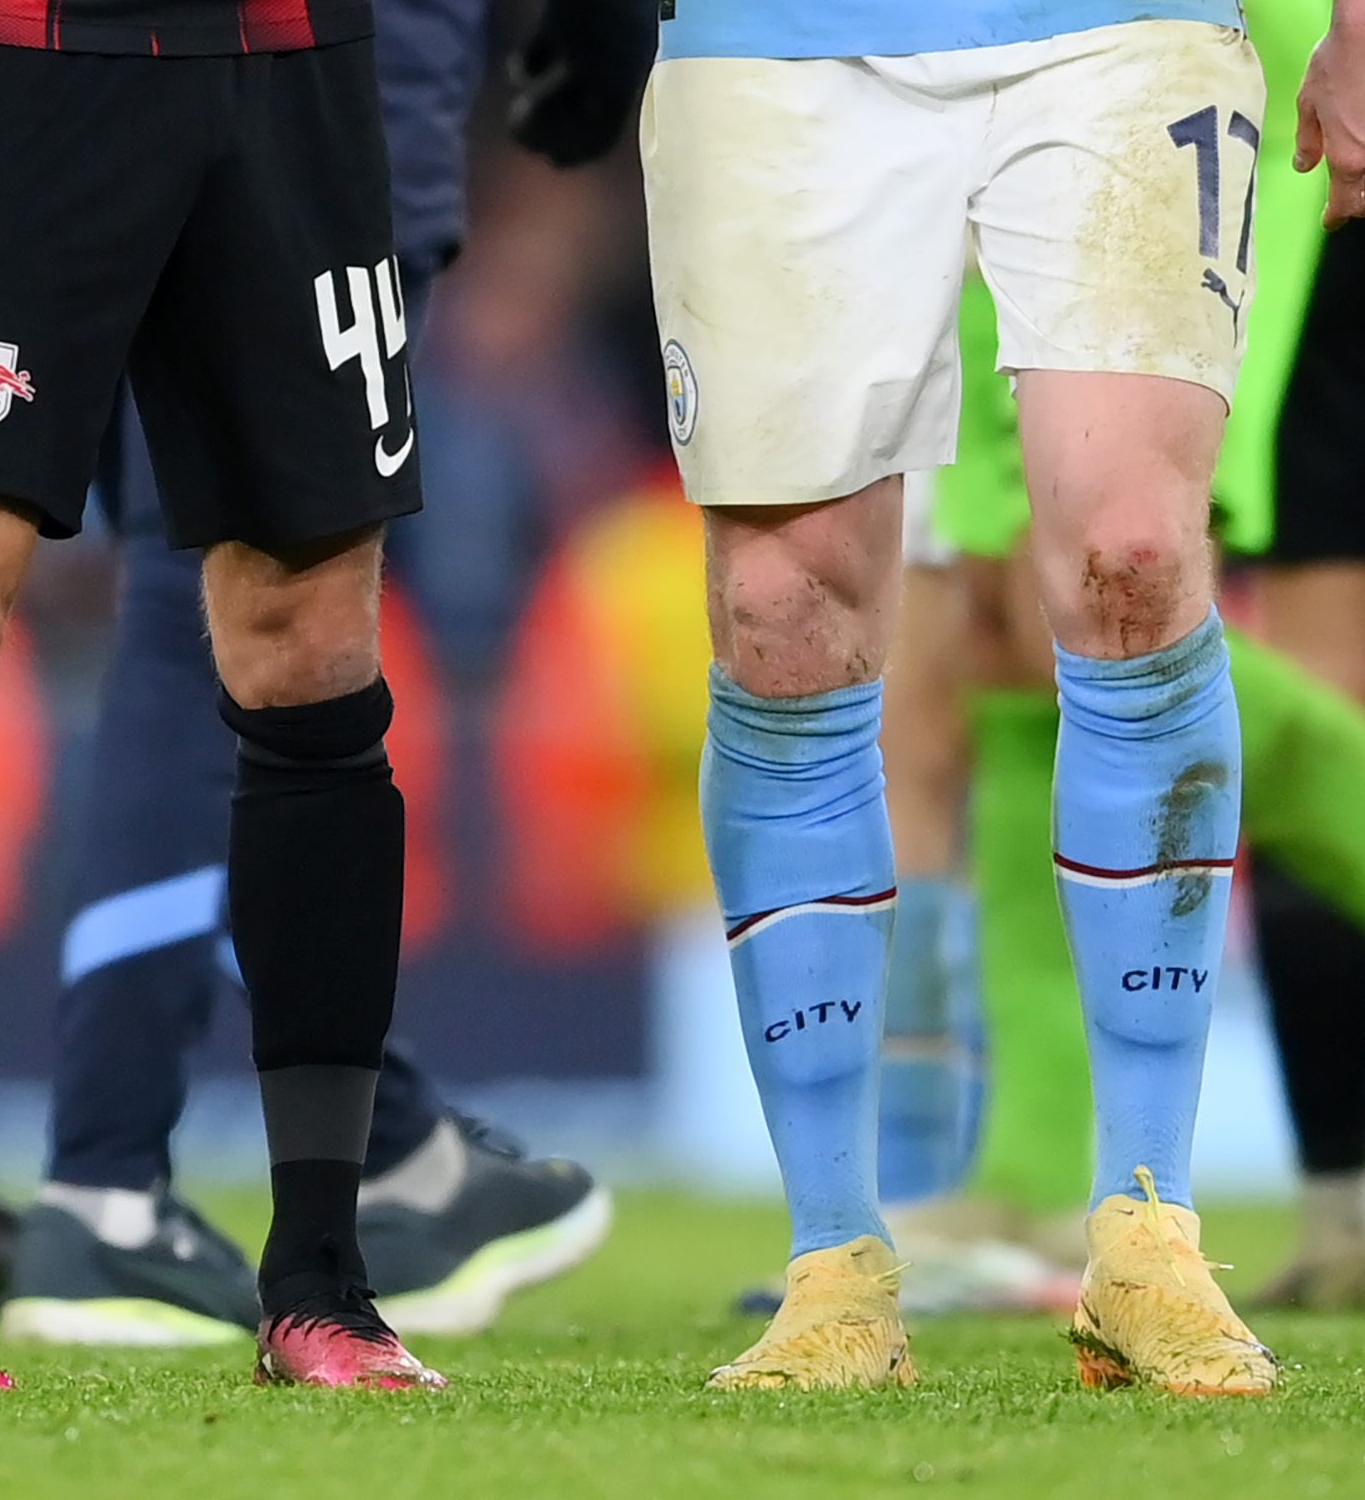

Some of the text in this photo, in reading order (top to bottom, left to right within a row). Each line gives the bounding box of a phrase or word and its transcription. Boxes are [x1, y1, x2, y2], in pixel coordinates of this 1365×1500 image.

[1166, 104, 1259, 275] 17
[314, 254, 411, 430] 44
[764, 1000, 862, 1043] CITY
[1122, 966, 1208, 993] CITY
